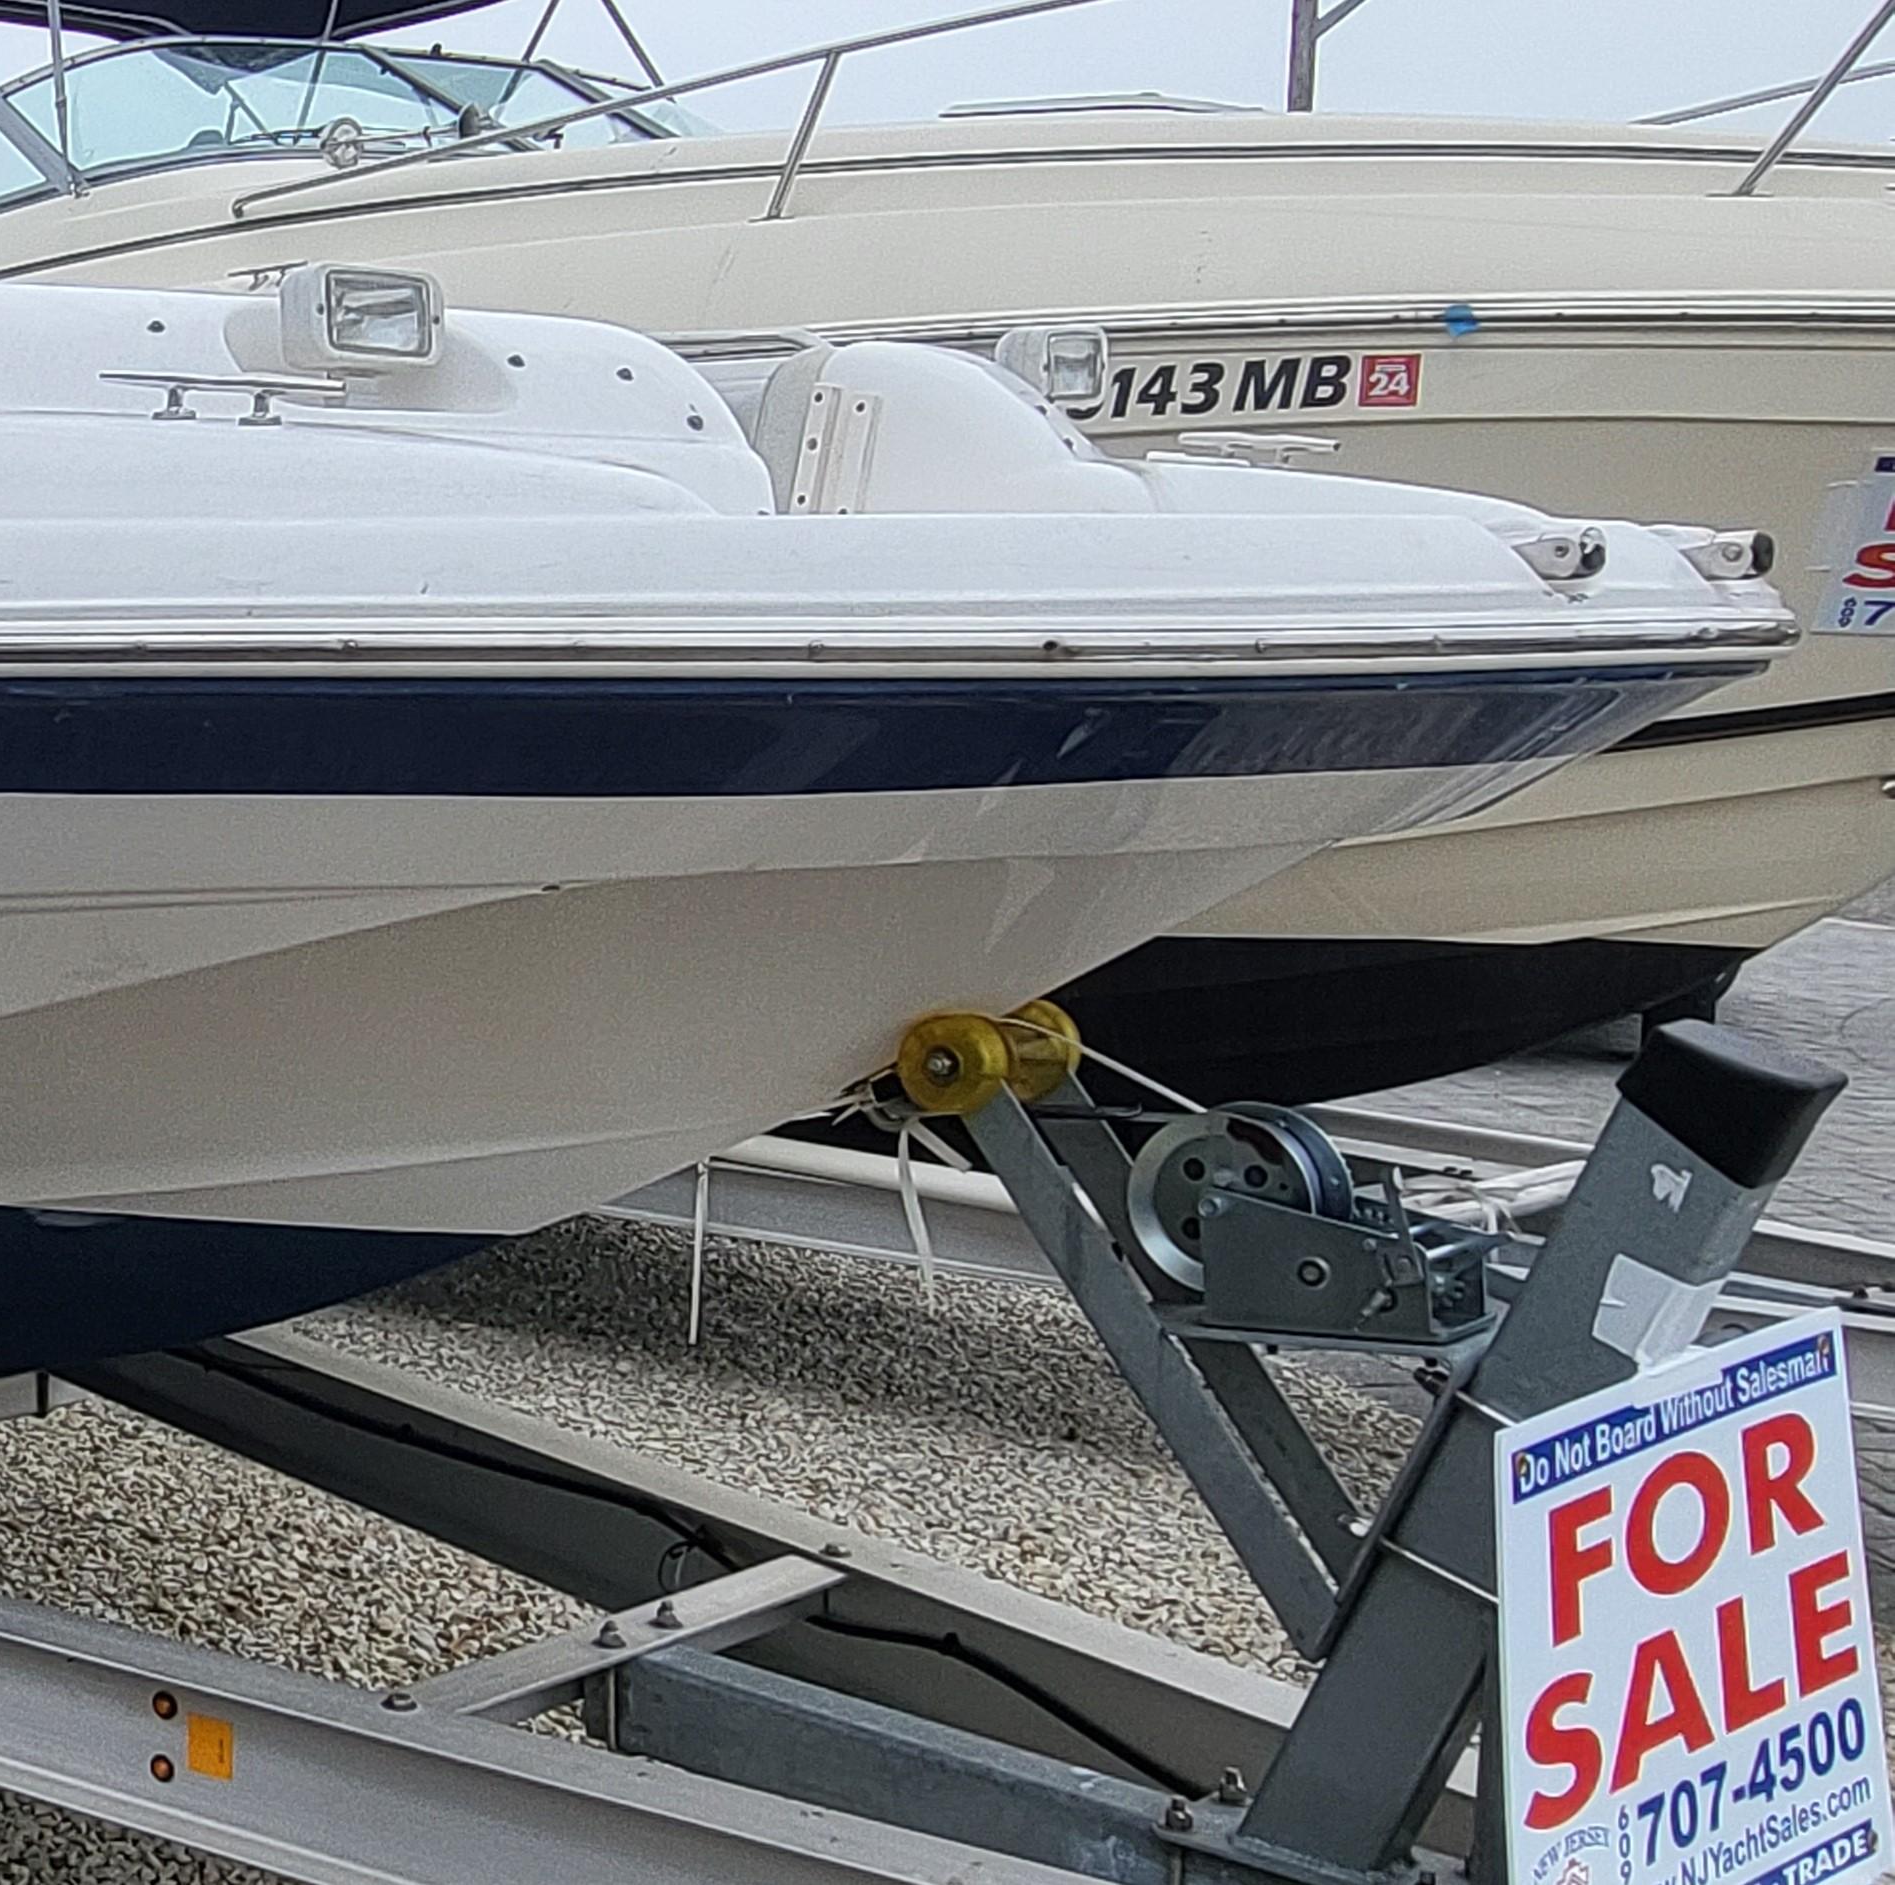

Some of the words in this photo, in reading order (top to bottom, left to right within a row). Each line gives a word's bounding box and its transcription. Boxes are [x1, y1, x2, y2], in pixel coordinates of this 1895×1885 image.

[1066, 362, 1225, 419] 143
[1233, 355, 1352, 412] MB
[1368, 372, 1410, 396] 24
[1519, 1454, 1549, 1494] Do
[1554, 1432, 1592, 1479] Not
[1596, 1405, 1656, 1462] Board
[1659, 1375, 1735, 1436] Without
[1736, 1349, 1830, 1403] Salesman
[1548, 1411, 1826, 1648] FOR
[1523, 1549, 1860, 1831] SALE
[1637, 1698, 1866, 1867] 707-4500
[1658, 1777, 1871, 1885] NJYachtSales.com
[1782, 1829, 1868, 1885] TRADE
